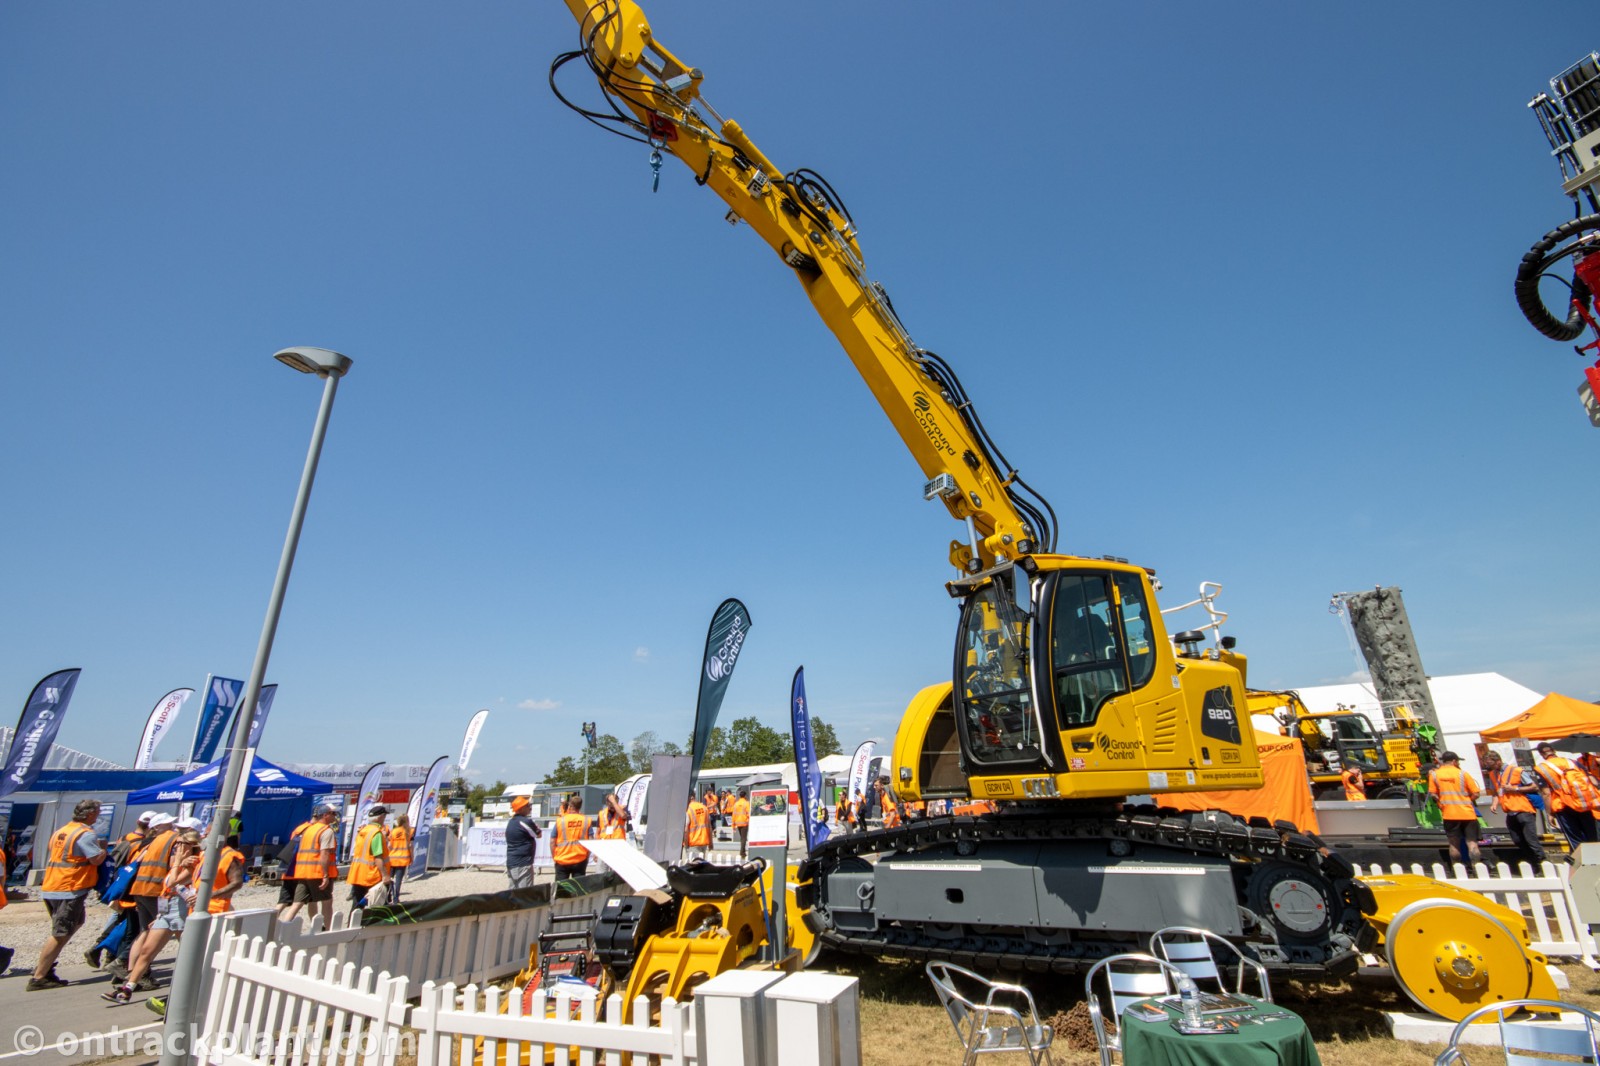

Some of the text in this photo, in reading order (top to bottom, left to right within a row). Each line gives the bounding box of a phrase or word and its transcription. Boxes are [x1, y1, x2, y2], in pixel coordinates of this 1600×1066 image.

[914, 408, 944, 451] Control
[926, 412, 956, 456] Ground
[718, 615, 741, 660] Ground
[723, 630, 744, 675] Control
[158, 701, 176, 723] Scott
[1207, 708, 1232, 720] 920
[1111, 739, 1140, 750] Ground
[1257, 743, 1294, 753] OUP.COM
[1107, 750, 1135, 760] Control
[856, 755, 867, 775] Scott
[312, 770, 352, 778] Sustainable
[492, 830, 506, 838] Scot
